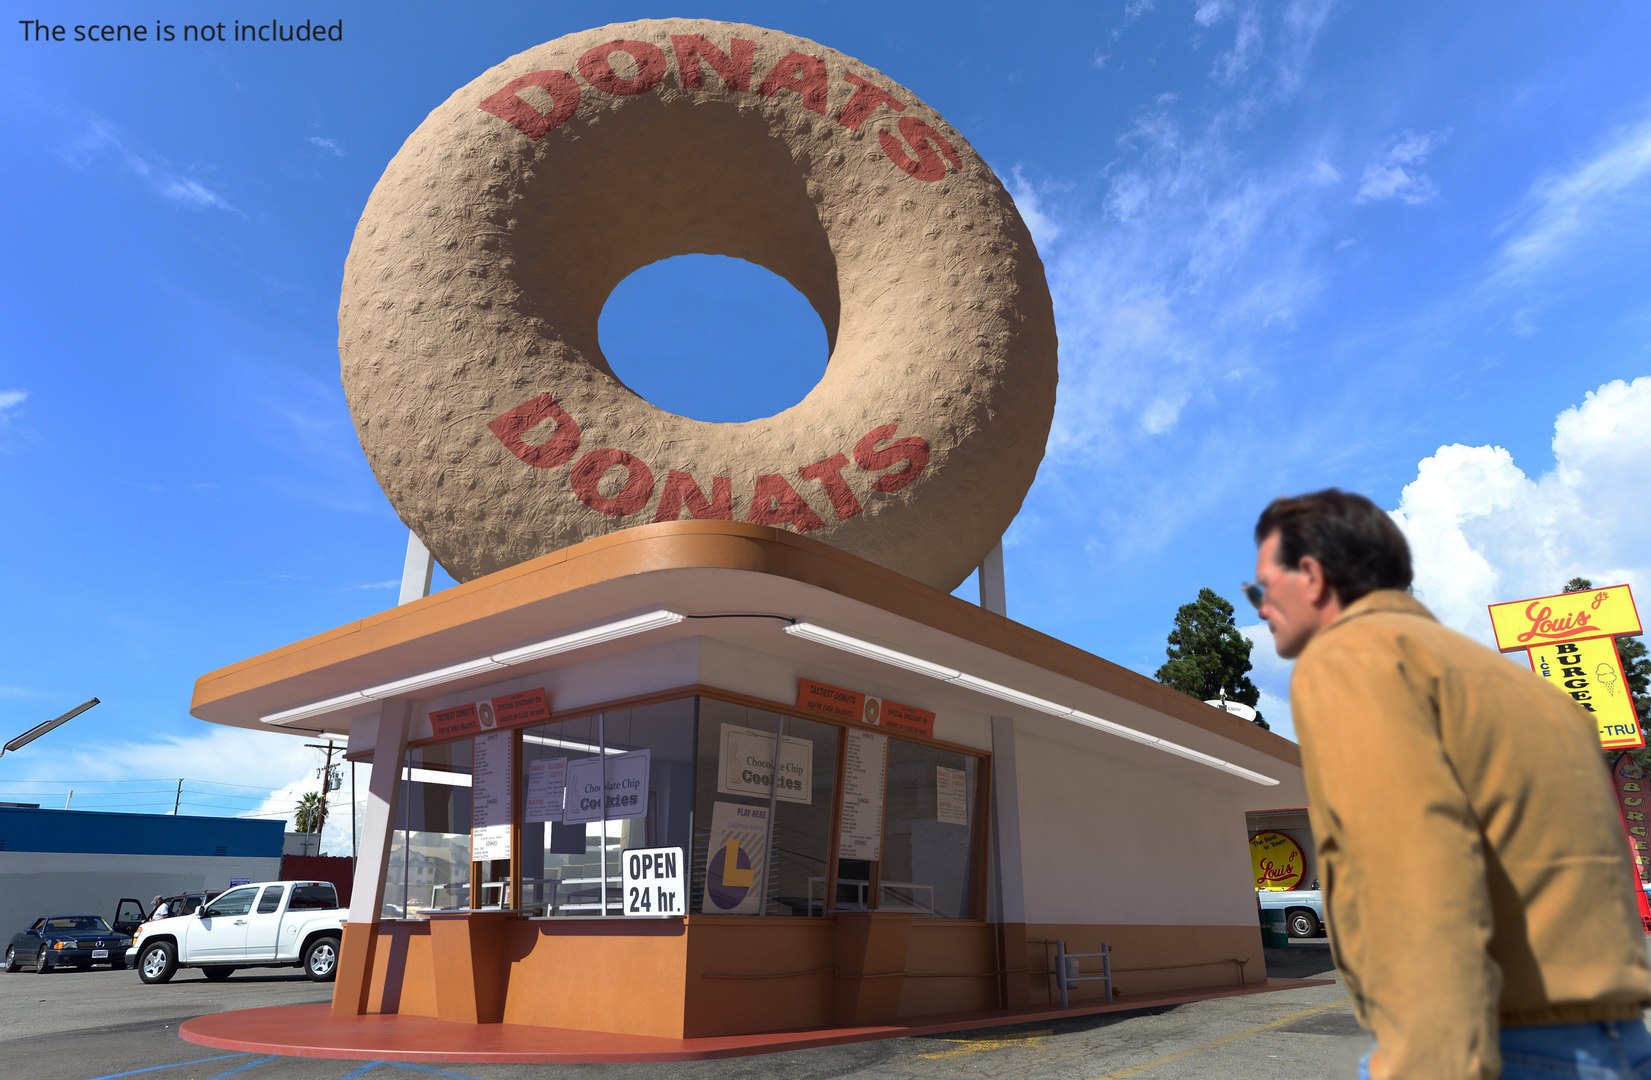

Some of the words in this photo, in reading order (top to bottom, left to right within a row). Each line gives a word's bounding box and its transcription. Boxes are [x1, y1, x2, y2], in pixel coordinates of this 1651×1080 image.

[478, 33, 964, 184] DONATS
[488, 391, 931, 533] DONATS
[1517, 601, 1601, 643] Louis
[1540, 655, 1552, 678] ICE
[1555, 643, 1597, 713] BURGE
[809, 685, 834, 700] TASTIEST
[835, 691, 857, 705] DONUTS
[456, 706, 475, 719] DONUTS
[822, 703, 834, 713] EVER
[1600, 723, 1636, 736] -TRU
[747, 756, 785, 772] Chocole
[786, 762, 804, 777] Chip
[584, 780, 621, 793] Choclate
[622, 778, 641, 790] Chip
[737, 807, 751, 817] PLAY
[752, 809, 767, 819] HERE
[630, 852, 677, 880] OPEN
[1257, 857, 1299, 884] Louis
[629, 886, 652, 912] 24
[657, 886, 681, 912] hr.
